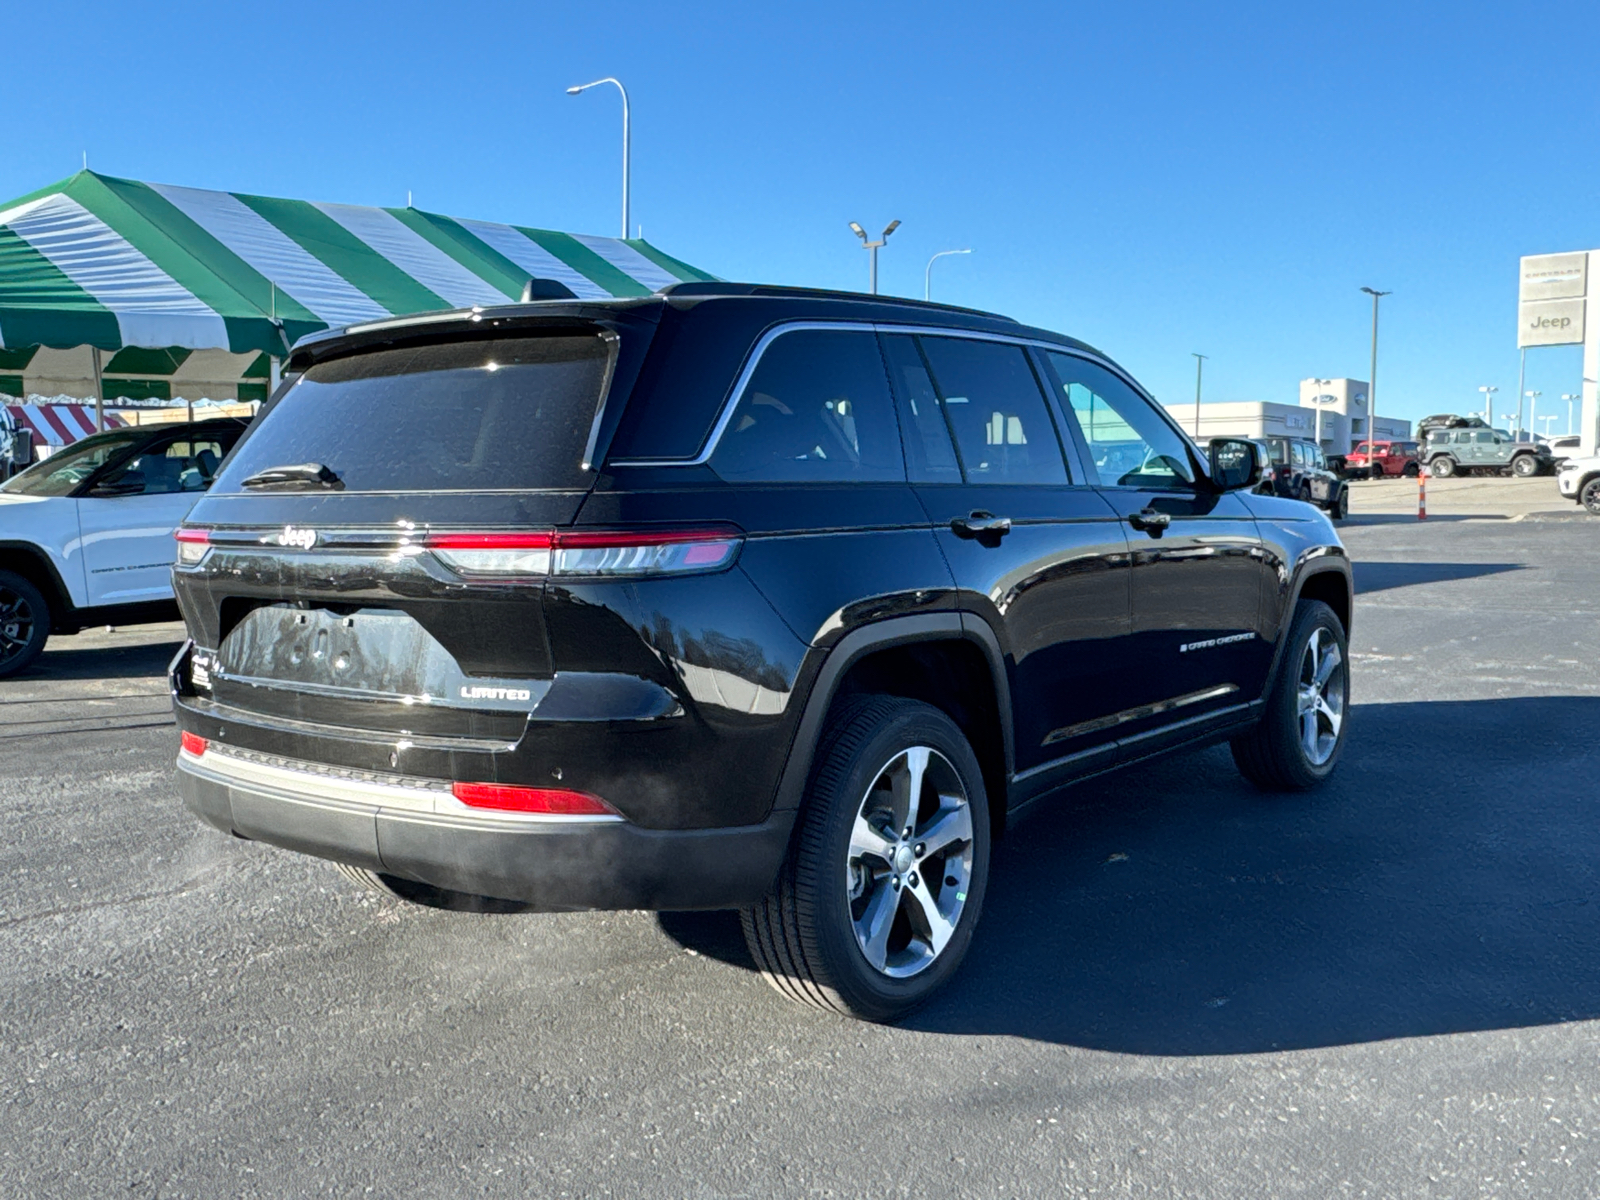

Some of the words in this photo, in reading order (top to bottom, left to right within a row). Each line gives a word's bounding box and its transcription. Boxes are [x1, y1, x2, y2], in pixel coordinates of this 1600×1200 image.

[1530, 316, 1571, 329] Jeep
[278, 525, 316, 550] Jeep
[460, 686, 531, 701] LIMITED
